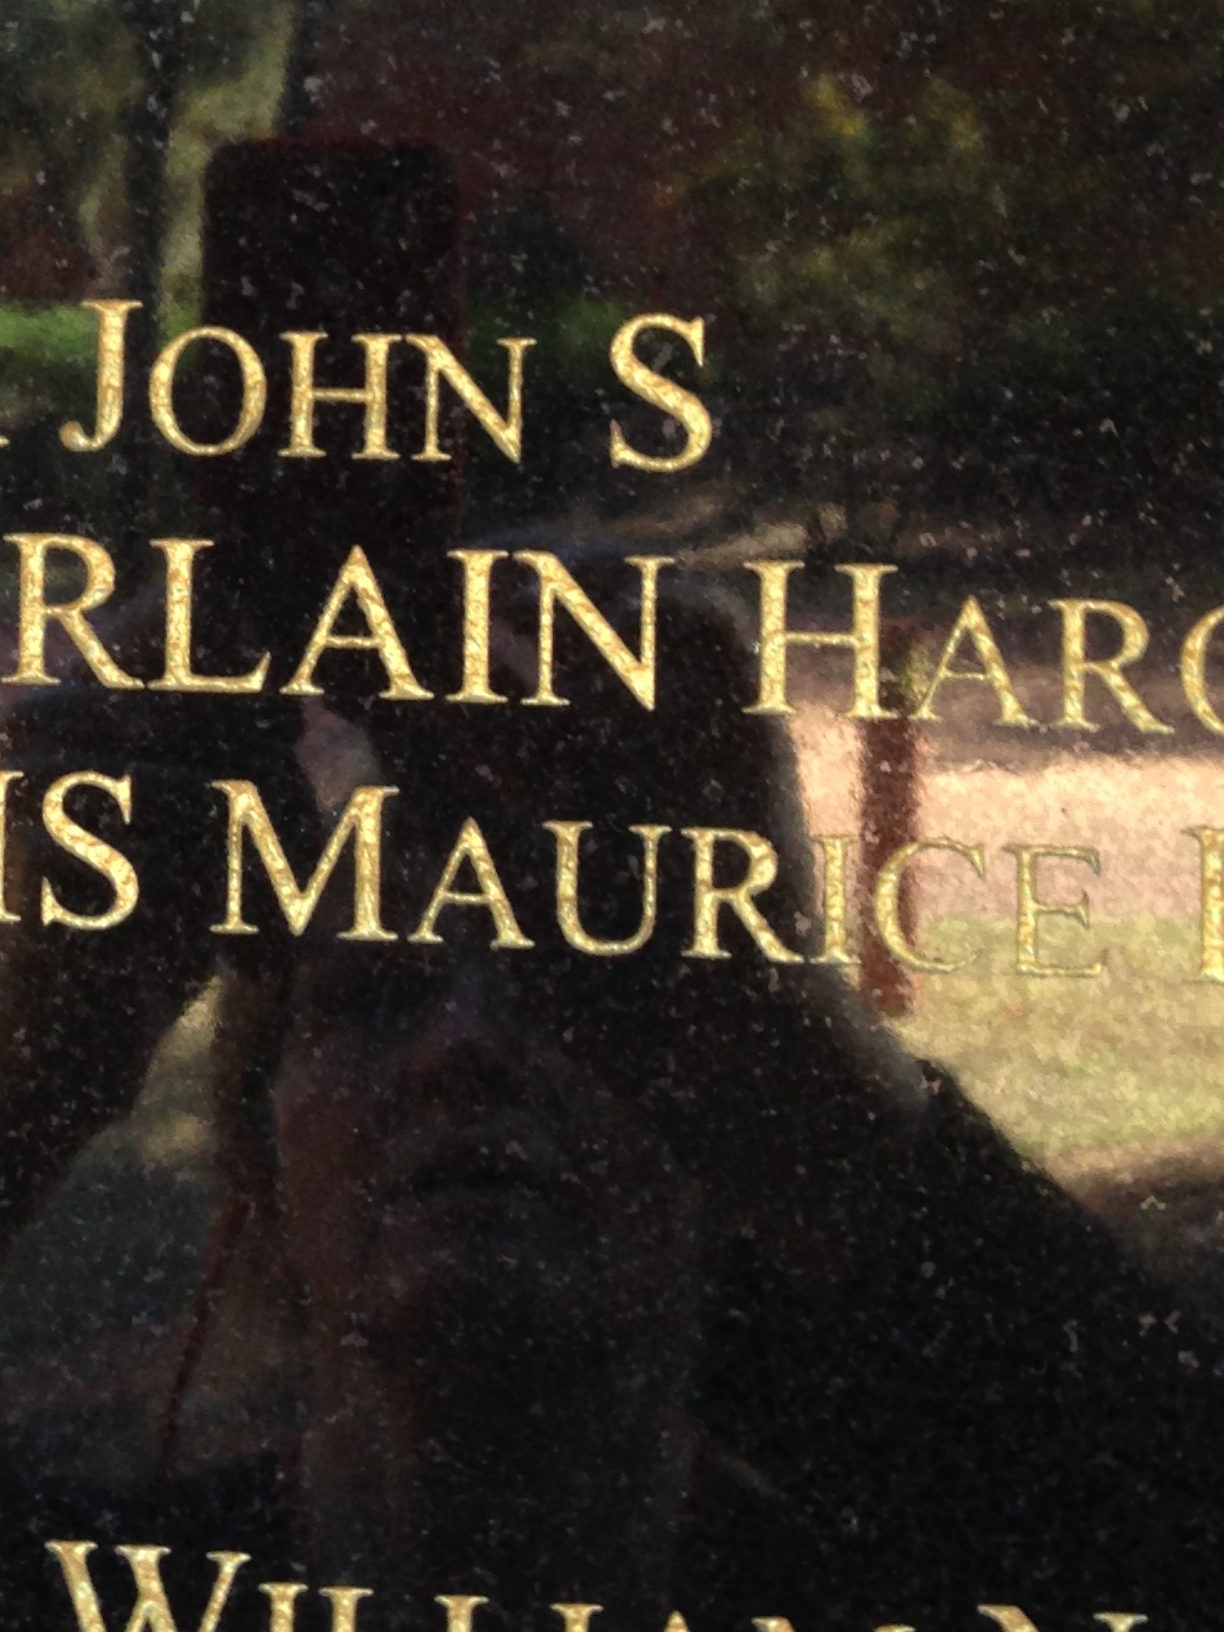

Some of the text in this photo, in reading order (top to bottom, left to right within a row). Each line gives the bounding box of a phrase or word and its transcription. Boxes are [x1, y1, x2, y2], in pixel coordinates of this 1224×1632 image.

[57, 298, 538, 465] JOHN
[608, 312, 714, 472] S
[210, 779, 1107, 979] MAURICE
